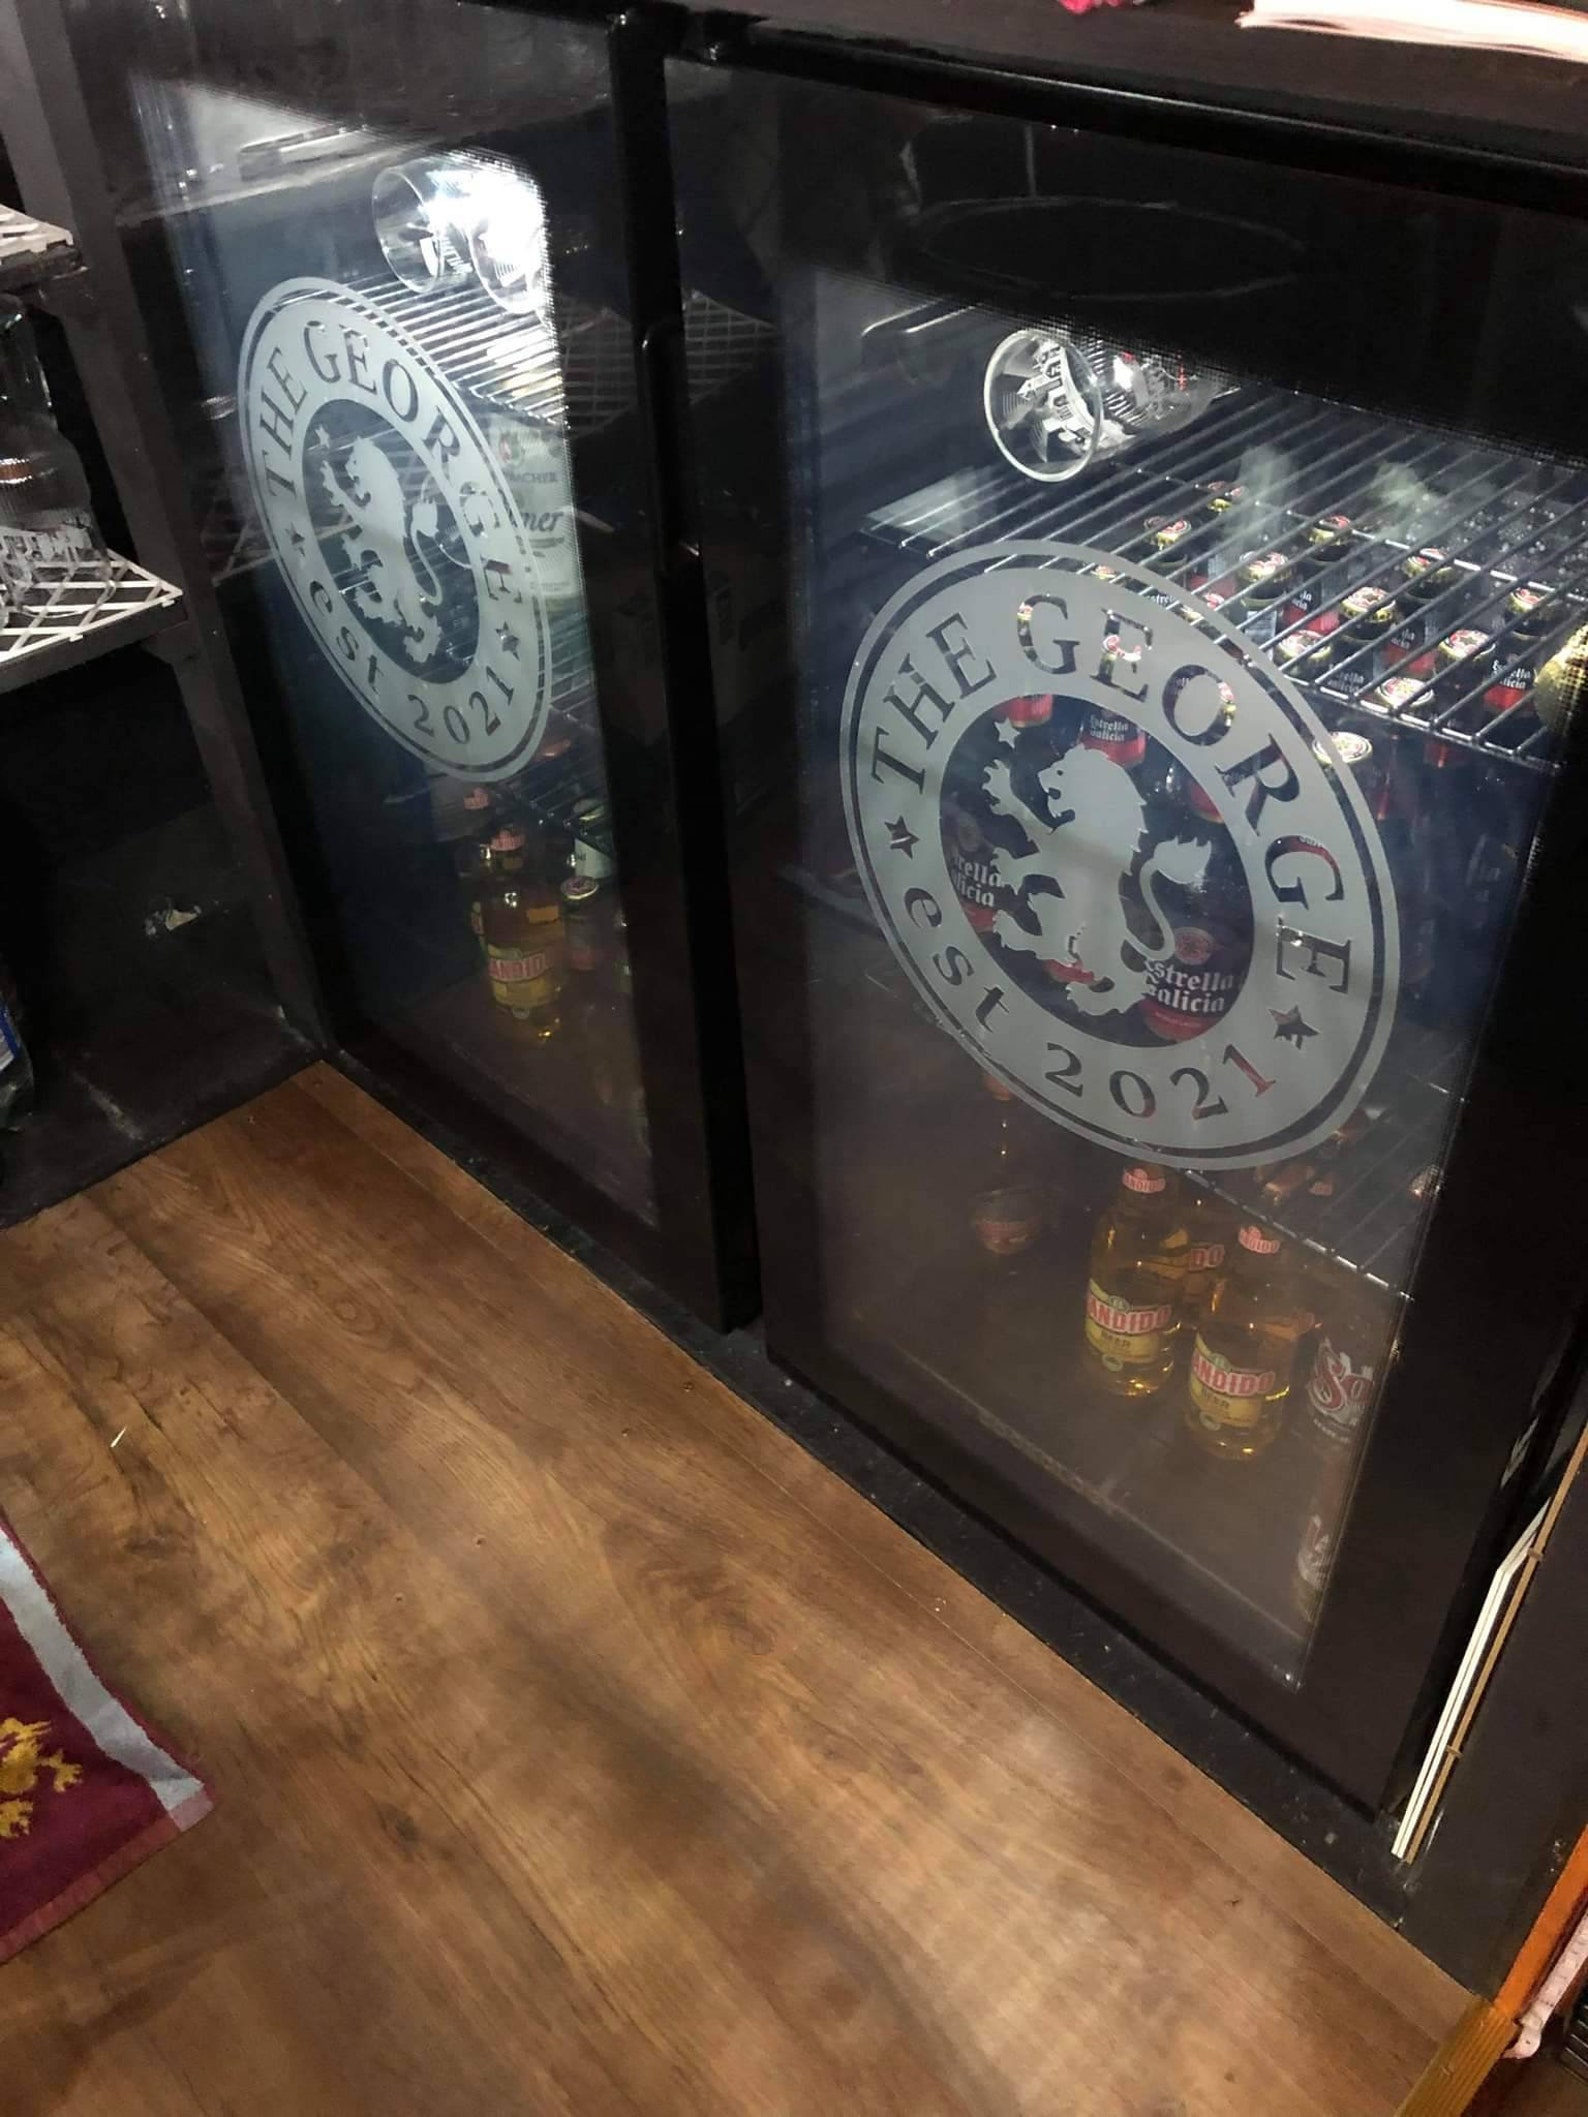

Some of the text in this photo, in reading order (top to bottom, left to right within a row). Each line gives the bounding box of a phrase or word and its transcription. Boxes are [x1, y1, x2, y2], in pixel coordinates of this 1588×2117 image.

[260, 320, 523, 604] THE GEORGE
[310, 580, 515, 744] est 2021
[872, 593, 1351, 995] THE GEORGE
[904, 887, 1278, 1121] est 2021
